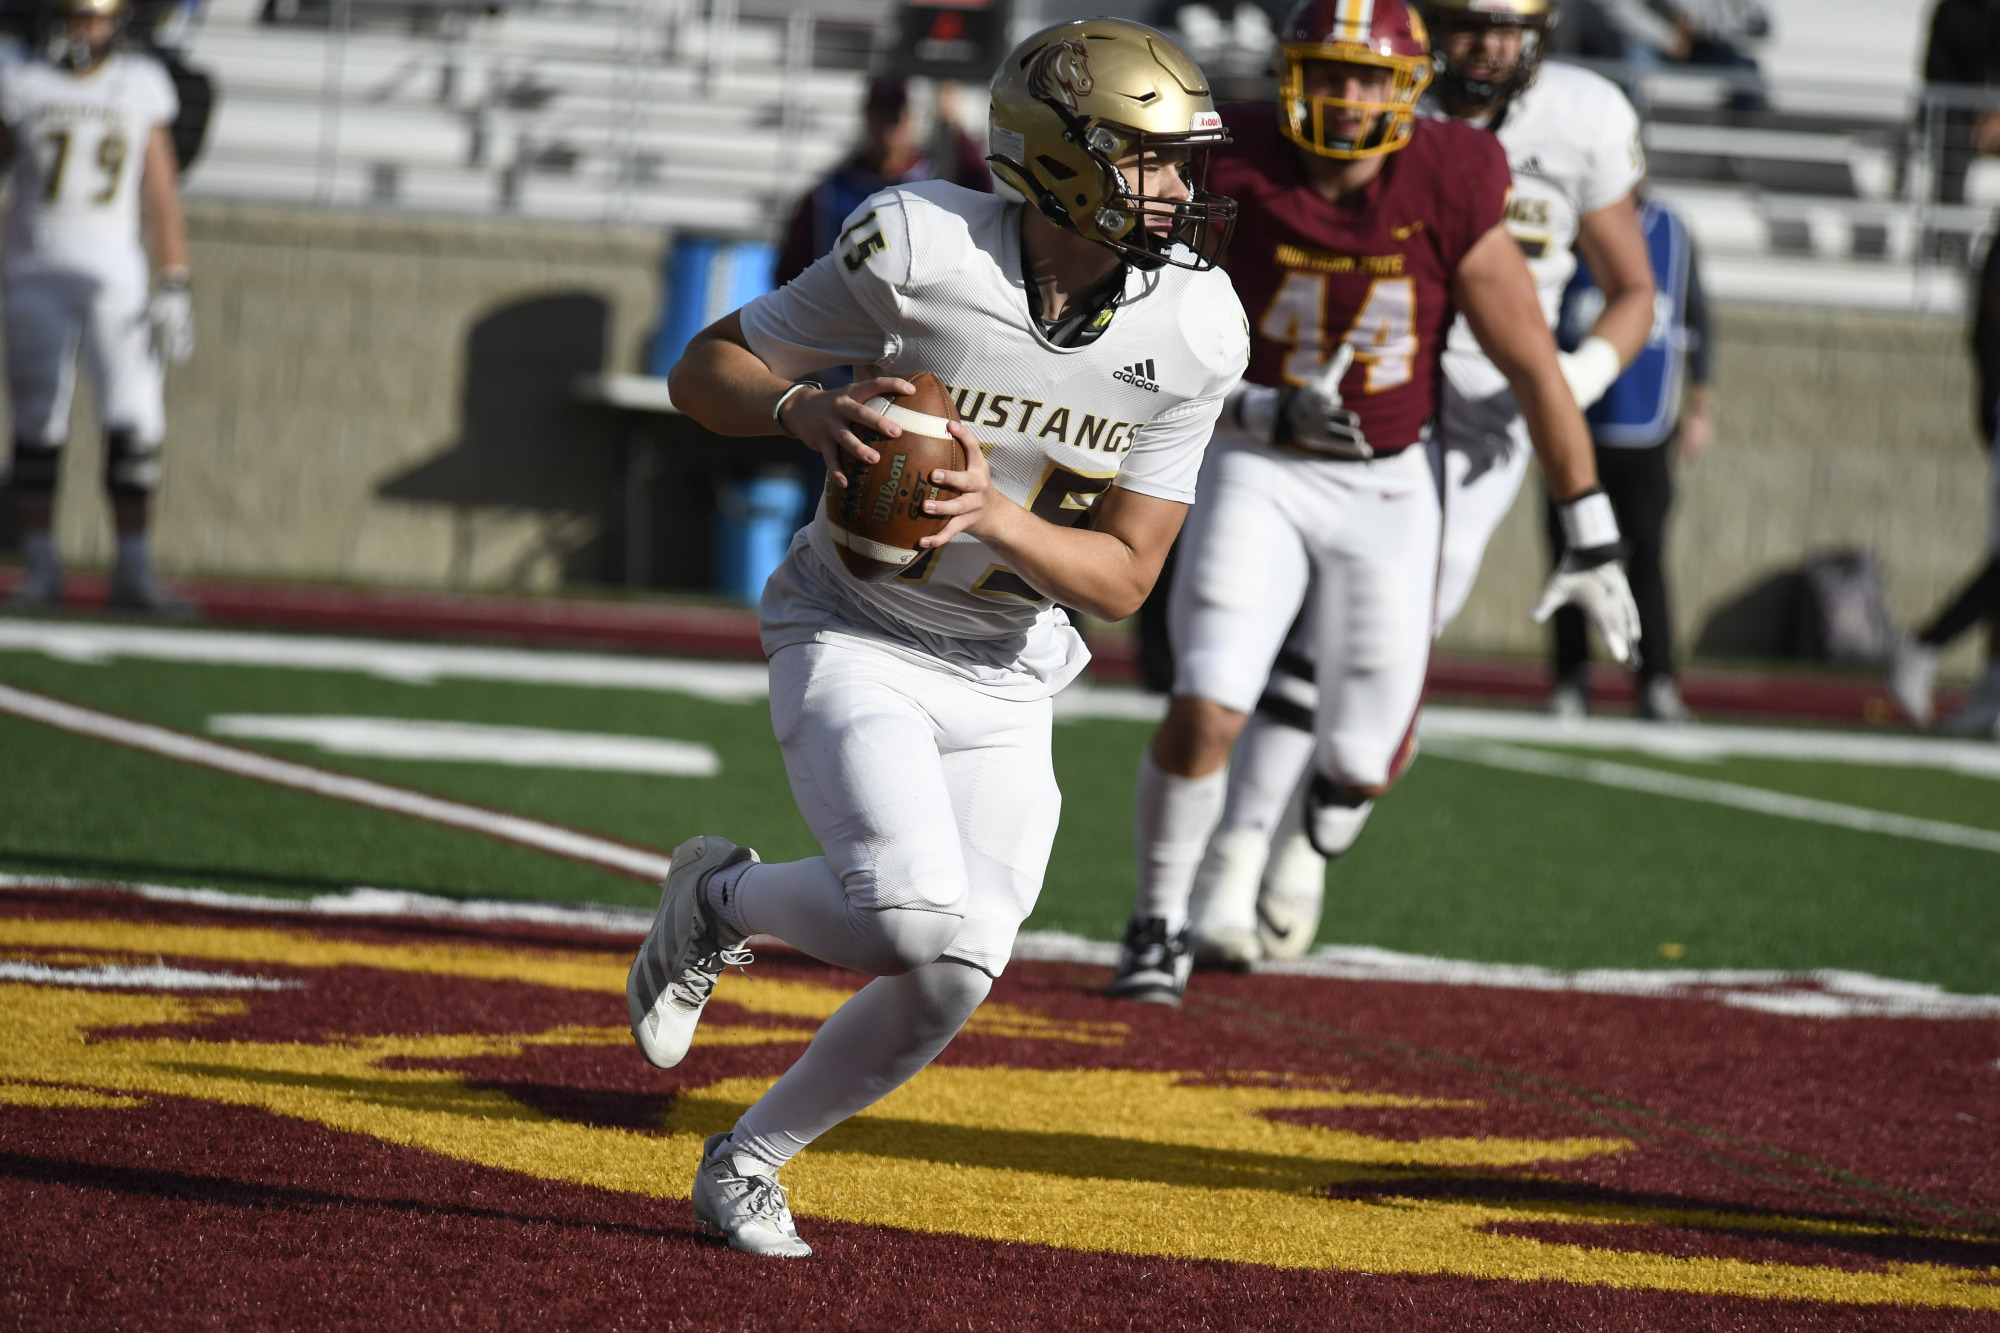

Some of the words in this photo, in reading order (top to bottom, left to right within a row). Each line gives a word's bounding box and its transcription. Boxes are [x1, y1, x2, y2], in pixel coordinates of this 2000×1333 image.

[43, 131, 126, 204] 79
[840, 208, 889, 275] 15
[1259, 271, 1420, 394] 44
[1113, 370, 1160, 392] adidas
[944, 385, 1145, 453] USTANGS
[872, 453, 906, 522] Wilson
[908, 471, 928, 520] GST
